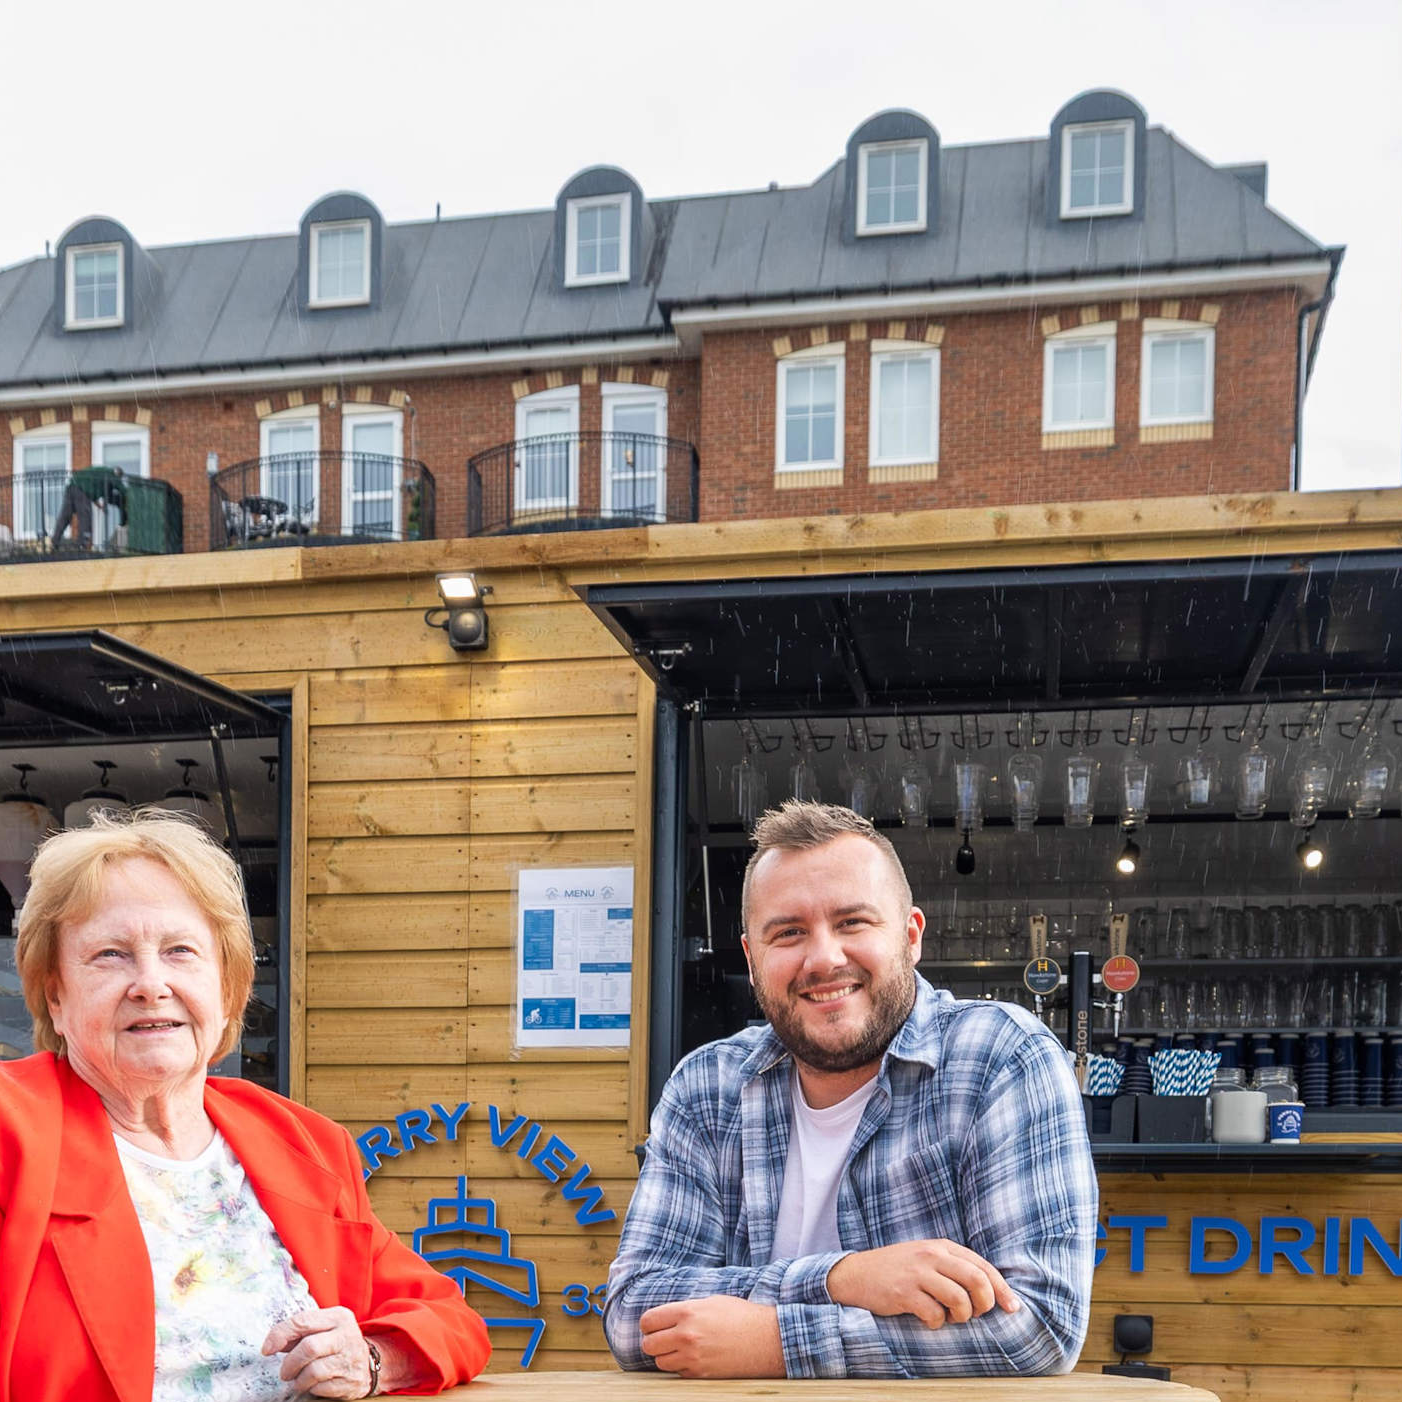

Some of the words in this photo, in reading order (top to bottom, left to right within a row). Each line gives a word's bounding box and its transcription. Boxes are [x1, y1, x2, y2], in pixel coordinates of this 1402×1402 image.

[564, 889, 595, 898] MENU
[1076, 1010, 1089, 1062] kstone
[355, 1101, 473, 1183] RRY
[487, 1103, 618, 1227] VIEW
[1092, 1214, 1169, 1274] T
